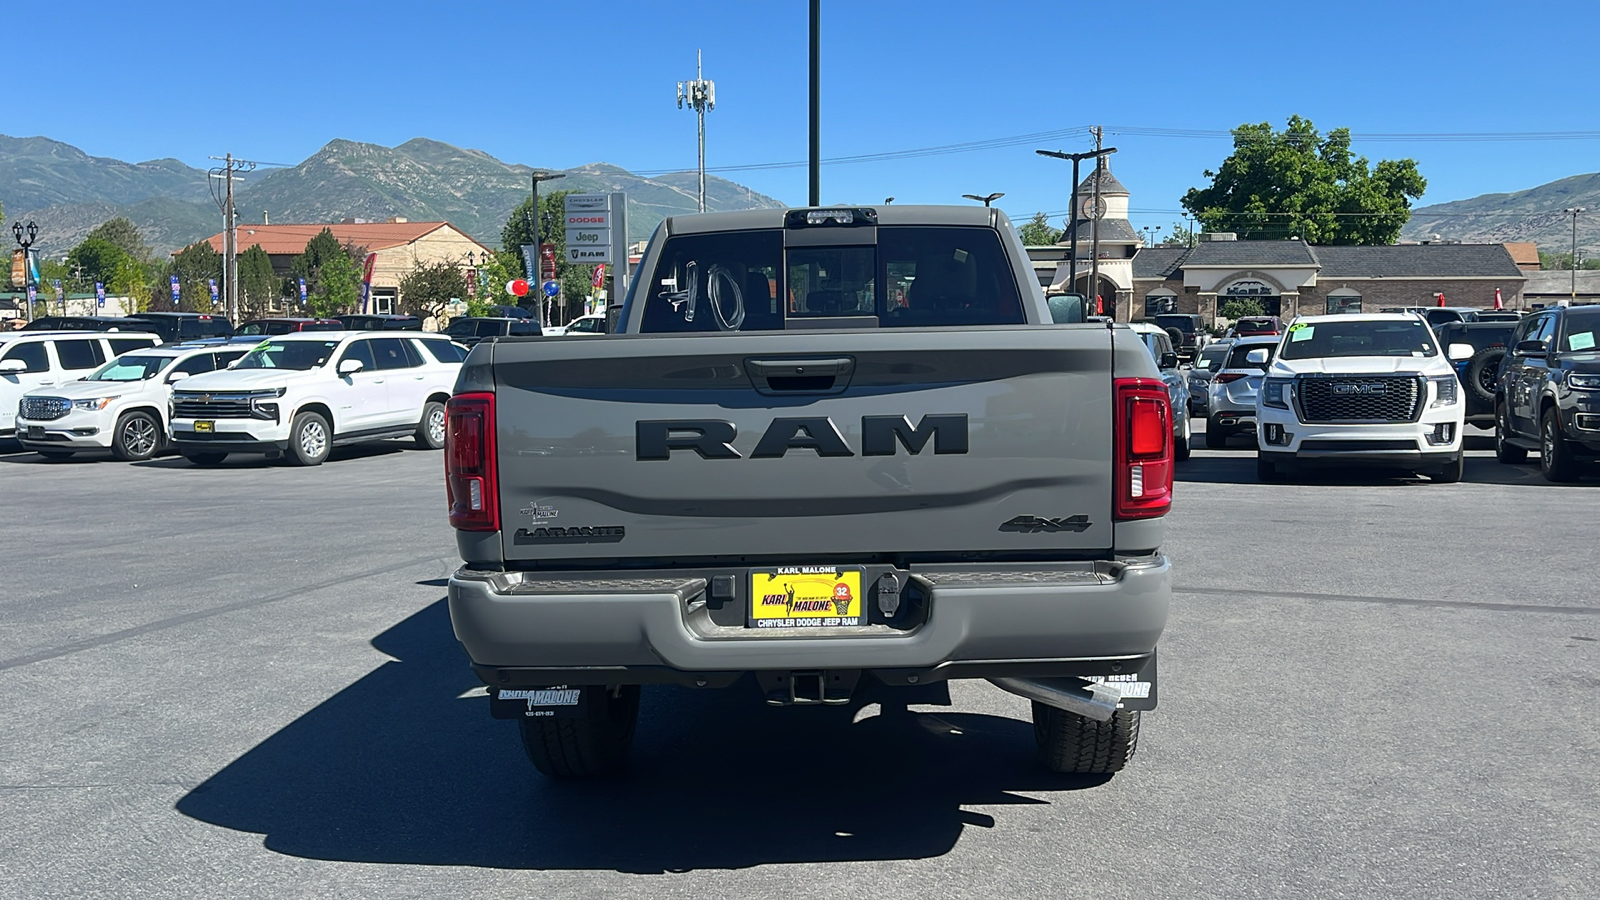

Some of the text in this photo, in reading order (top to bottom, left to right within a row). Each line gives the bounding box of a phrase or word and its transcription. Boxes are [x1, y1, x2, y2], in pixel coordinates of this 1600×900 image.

[576, 232, 598, 242] Jeep
[1333, 384, 1384, 395] GMC
[636, 413, 969, 461] RAM
[515, 526, 626, 542] LARAMIE
[836, 587, 848, 596] 32
[762, 594, 787, 606] KARL
[793, 600, 832, 612] MALONE
[758, 619, 795, 627] CHRYSLER
[822, 618, 841, 626] JEEP
[533, 690, 580, 706] MALONE
